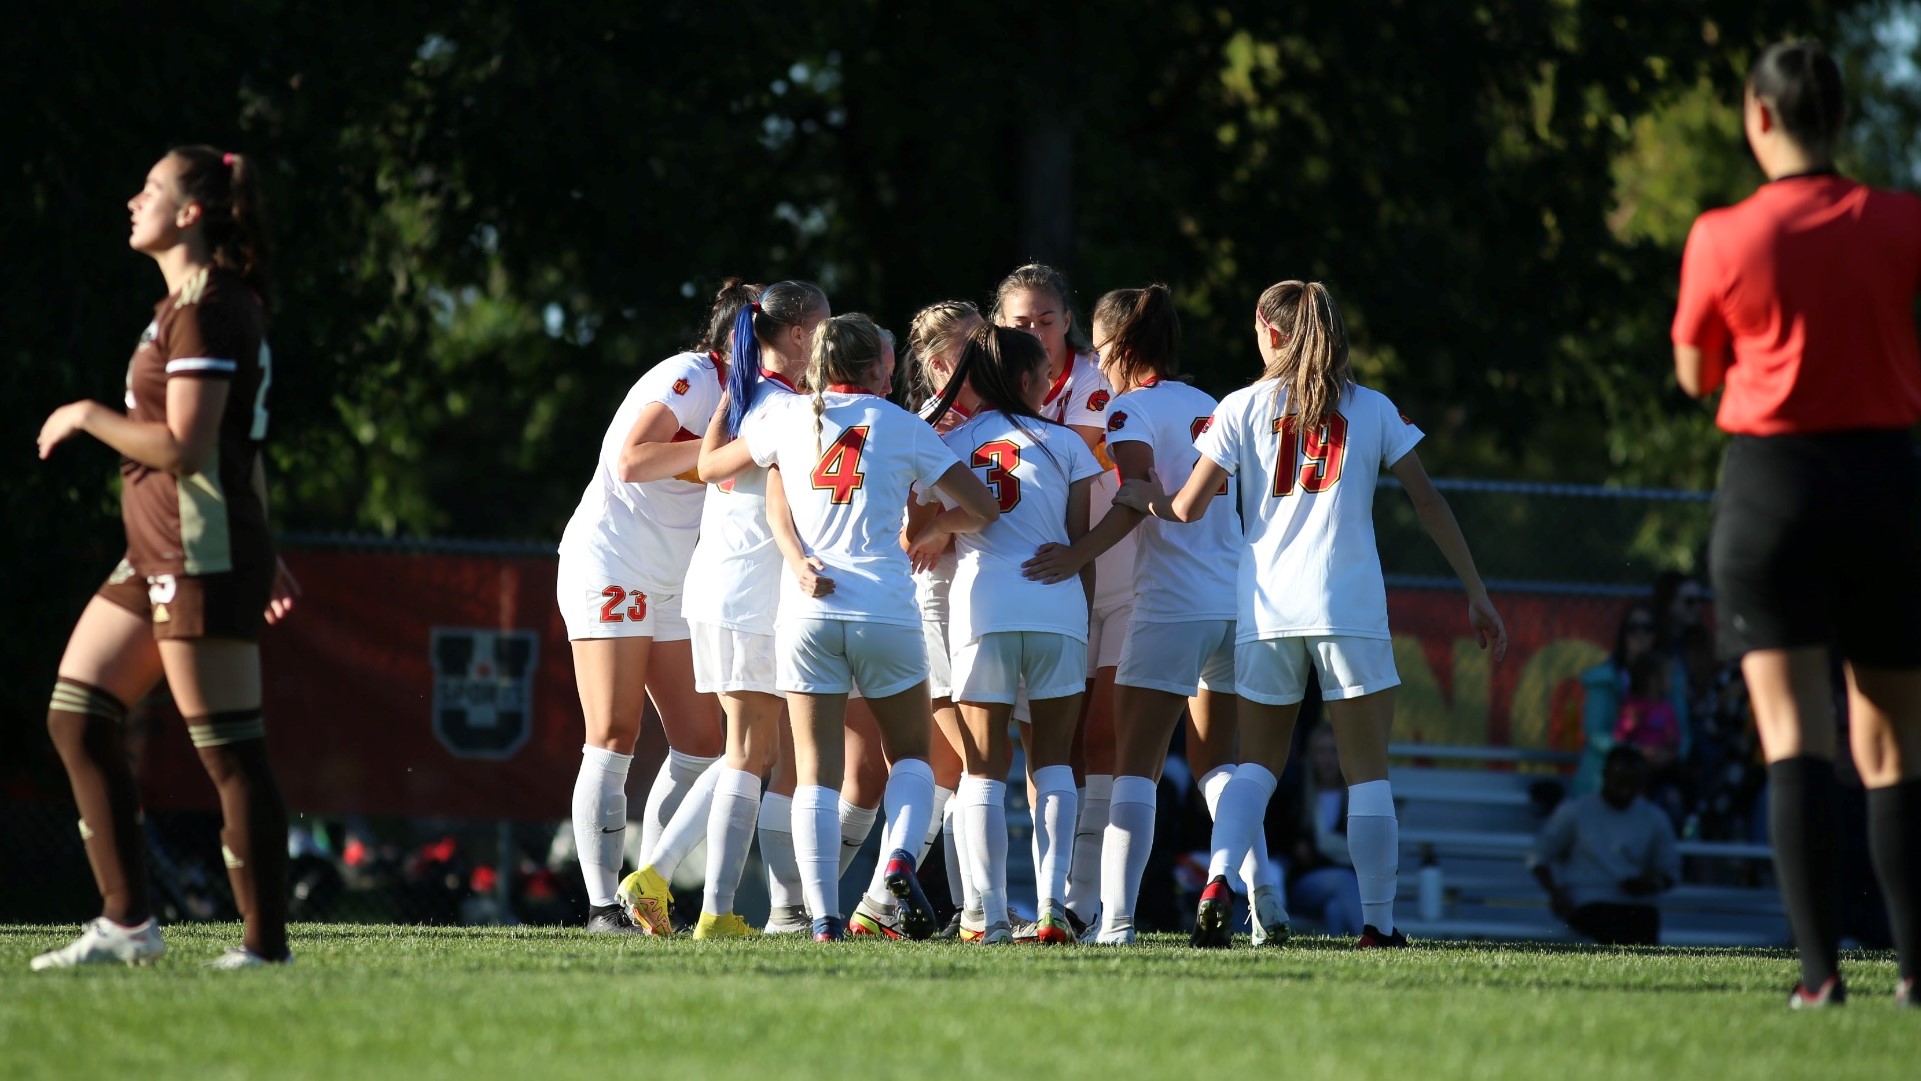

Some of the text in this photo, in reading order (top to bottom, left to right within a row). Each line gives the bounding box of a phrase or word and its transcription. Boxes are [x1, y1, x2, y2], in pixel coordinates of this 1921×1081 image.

[673, 380, 689, 395] CW
[810, 425, 870, 505] 4
[971, 439, 1022, 513] 3
[1272, 411, 1349, 498] 19
[600, 585, 647, 623] 23
